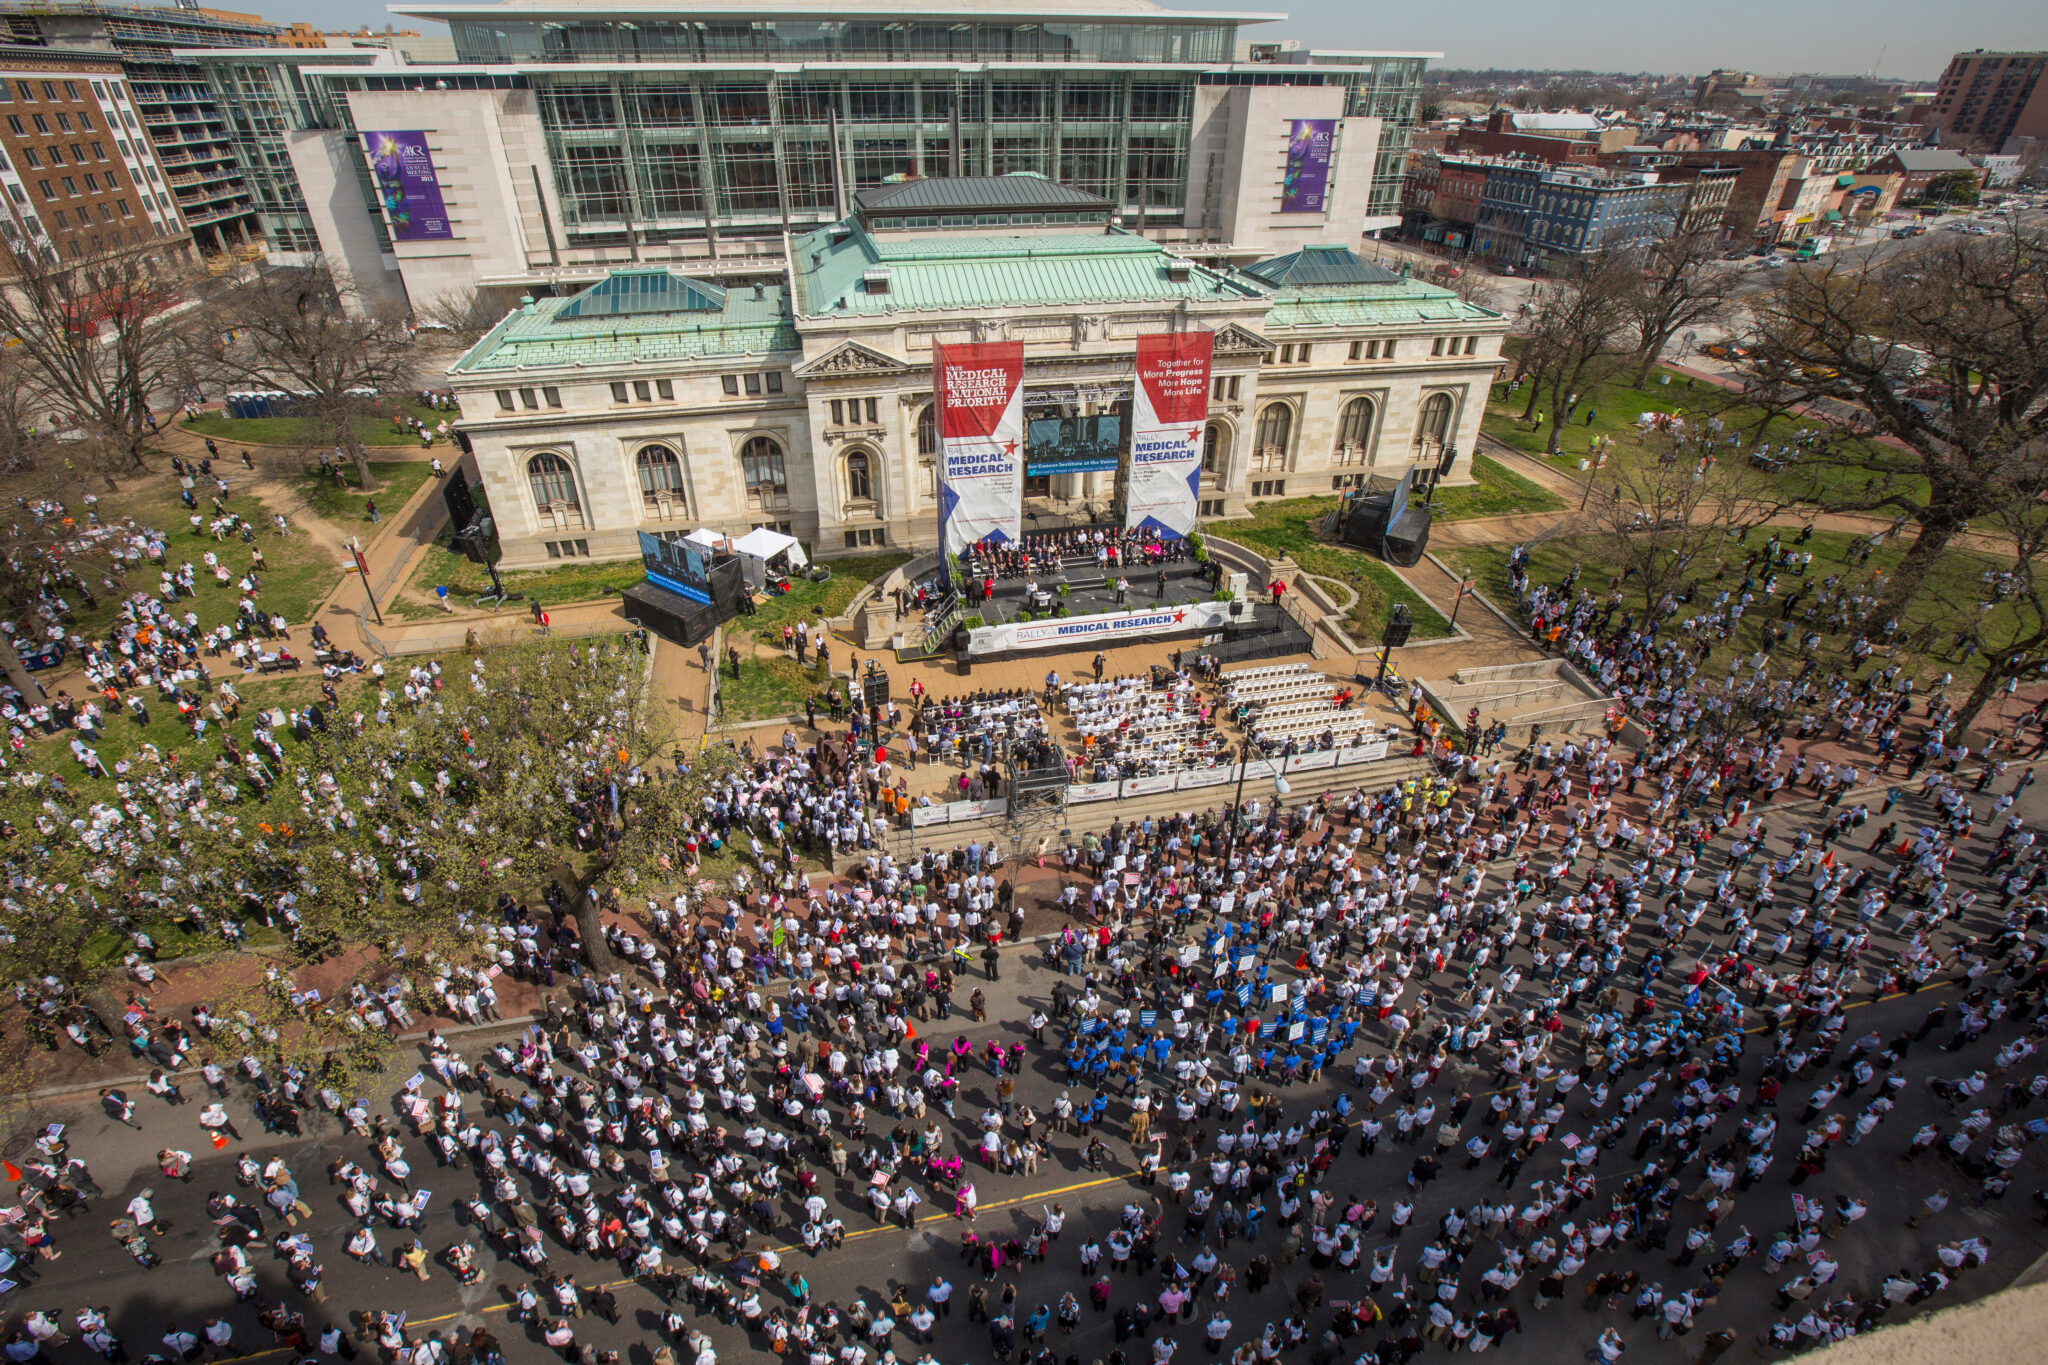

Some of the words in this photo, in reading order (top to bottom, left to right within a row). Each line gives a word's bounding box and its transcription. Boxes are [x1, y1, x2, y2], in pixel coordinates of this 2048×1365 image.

[1157, 358, 1191, 369] Together
[1193, 357, 1204, 366] for
[945, 368, 1007, 380] MEDICAL
[1143, 370, 1164, 379] More
[1165, 368, 1203, 378] Progress
[946, 377, 1007, 390] RESEARCH
[1158, 379, 1179, 387] More
[1180, 378, 1202, 387] Hope
[951, 387, 1007, 398] NATIONAL
[1163, 388, 1184, 397] More
[1185, 387, 1202, 395] Life
[946, 395, 1007, 408] PRIORITY!
[1135, 433, 1160, 441] RALLY
[947, 446, 973, 455] RALLY
[1135, 440, 1188, 452] MEDICAL
[947, 453, 1005, 466] MEDICAL
[1134, 449, 1195, 463] RESEARCH
[948, 463, 1014, 477] RESEARCH
[1016, 628, 1048, 640] RALLY
[1058, 622, 1110, 635] MEDICAL
[1112, 614, 1172, 629] RESEARCH
